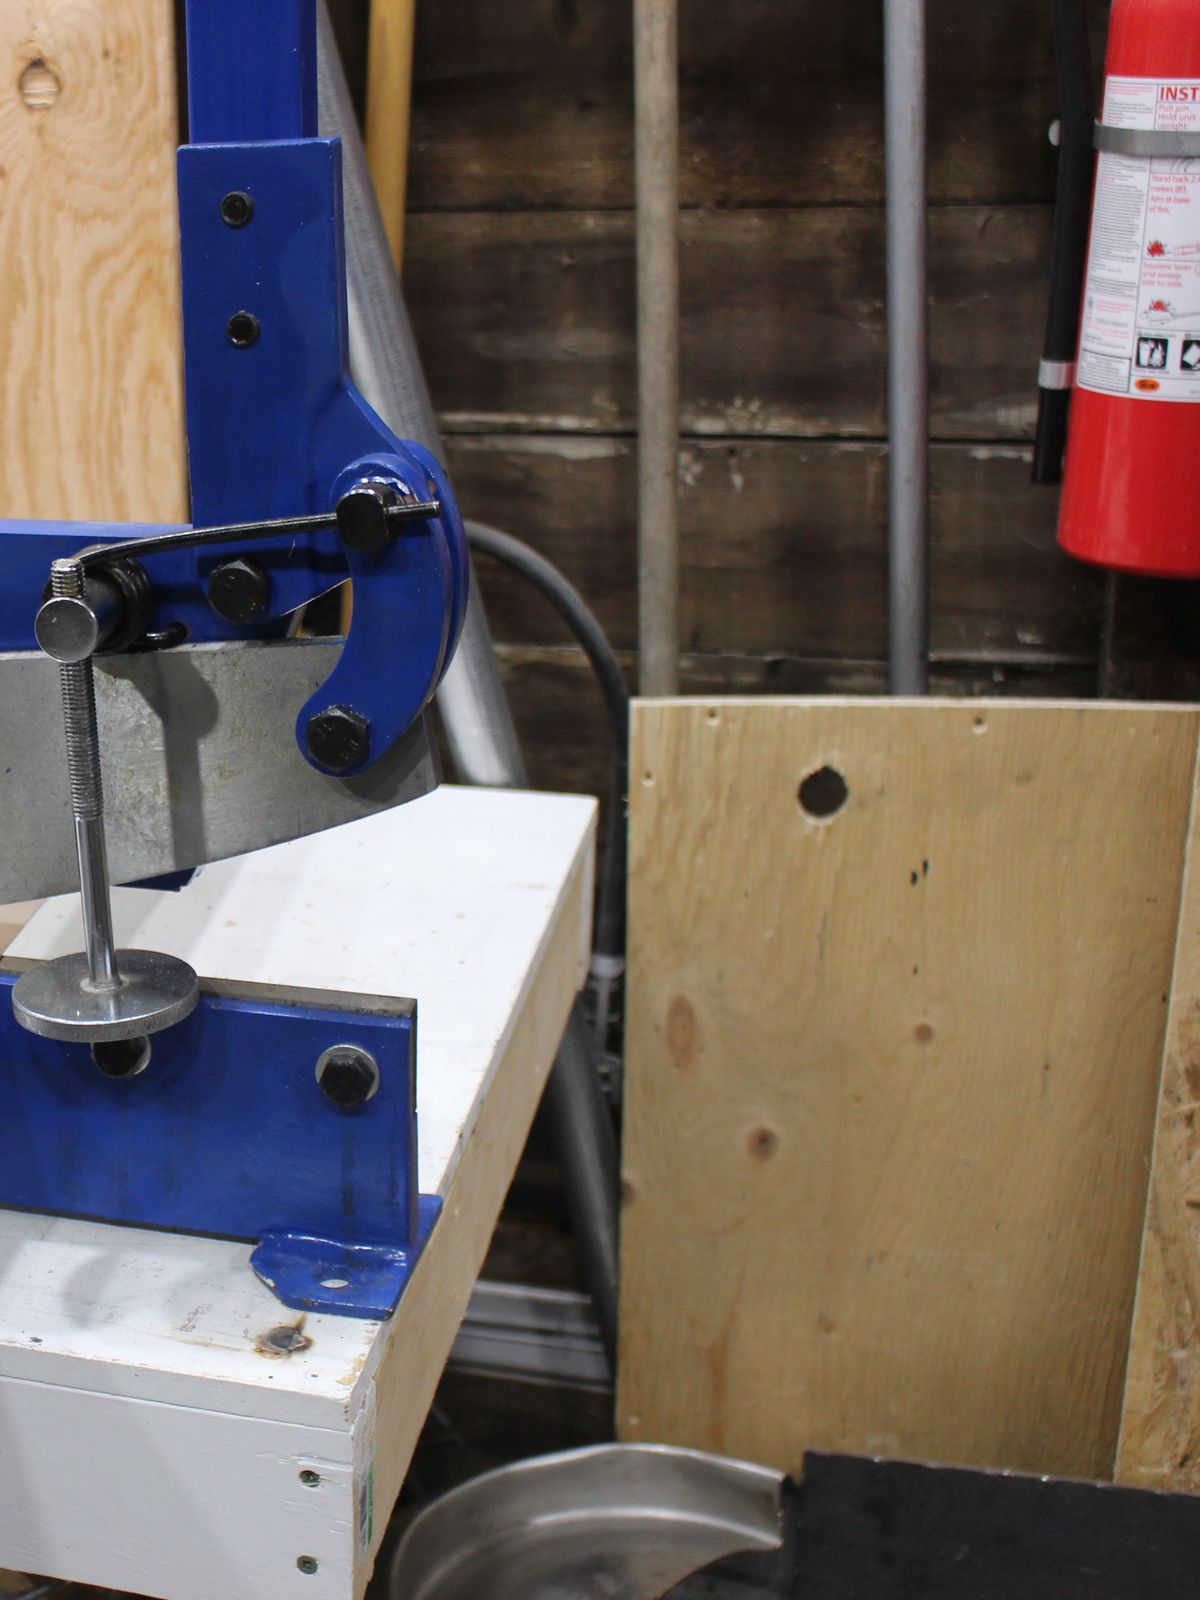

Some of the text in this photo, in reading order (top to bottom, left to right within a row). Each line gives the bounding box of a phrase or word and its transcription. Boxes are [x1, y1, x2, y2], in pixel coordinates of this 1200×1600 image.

[1159, 104, 1174, 112] Pull
[1158, 113, 1196, 121] Hold unit
[1151, 175, 1171, 183] Stand
[1172, 175, 1189, 183] back
[1173, 196, 1190, 204] base
